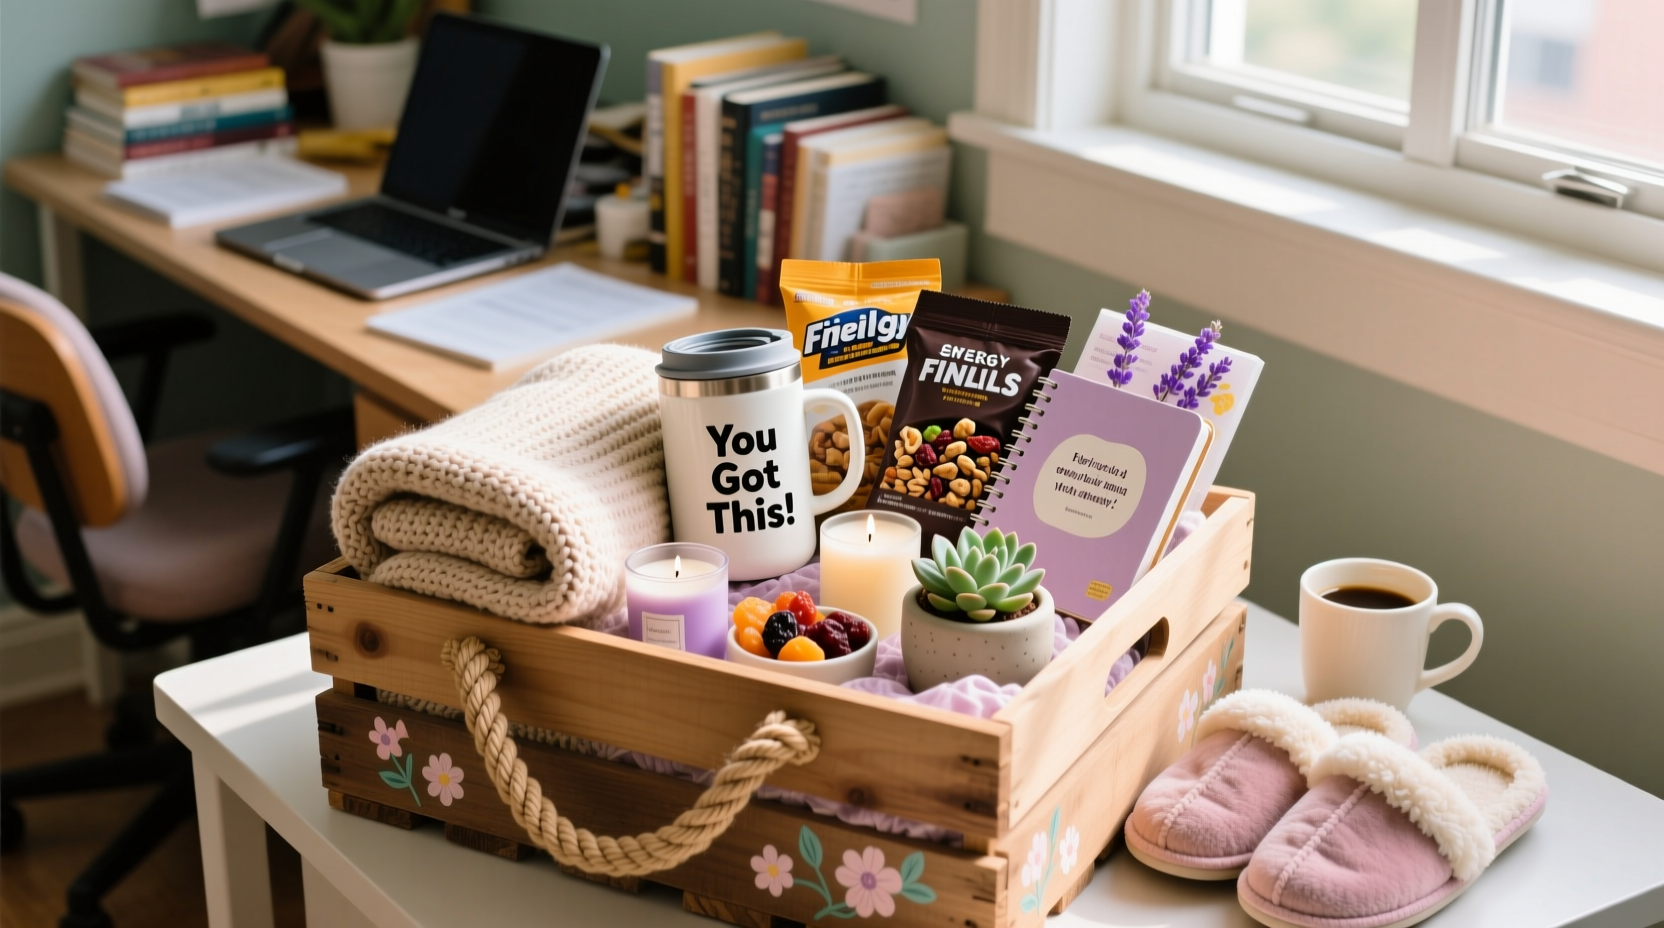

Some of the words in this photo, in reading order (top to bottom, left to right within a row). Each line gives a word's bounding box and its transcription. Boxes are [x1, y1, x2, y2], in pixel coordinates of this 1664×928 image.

[939, 344, 1010, 368] ENERGY
[706, 424, 777, 457] You
[712, 460, 781, 495] Got
[706, 492, 795, 534] This!
